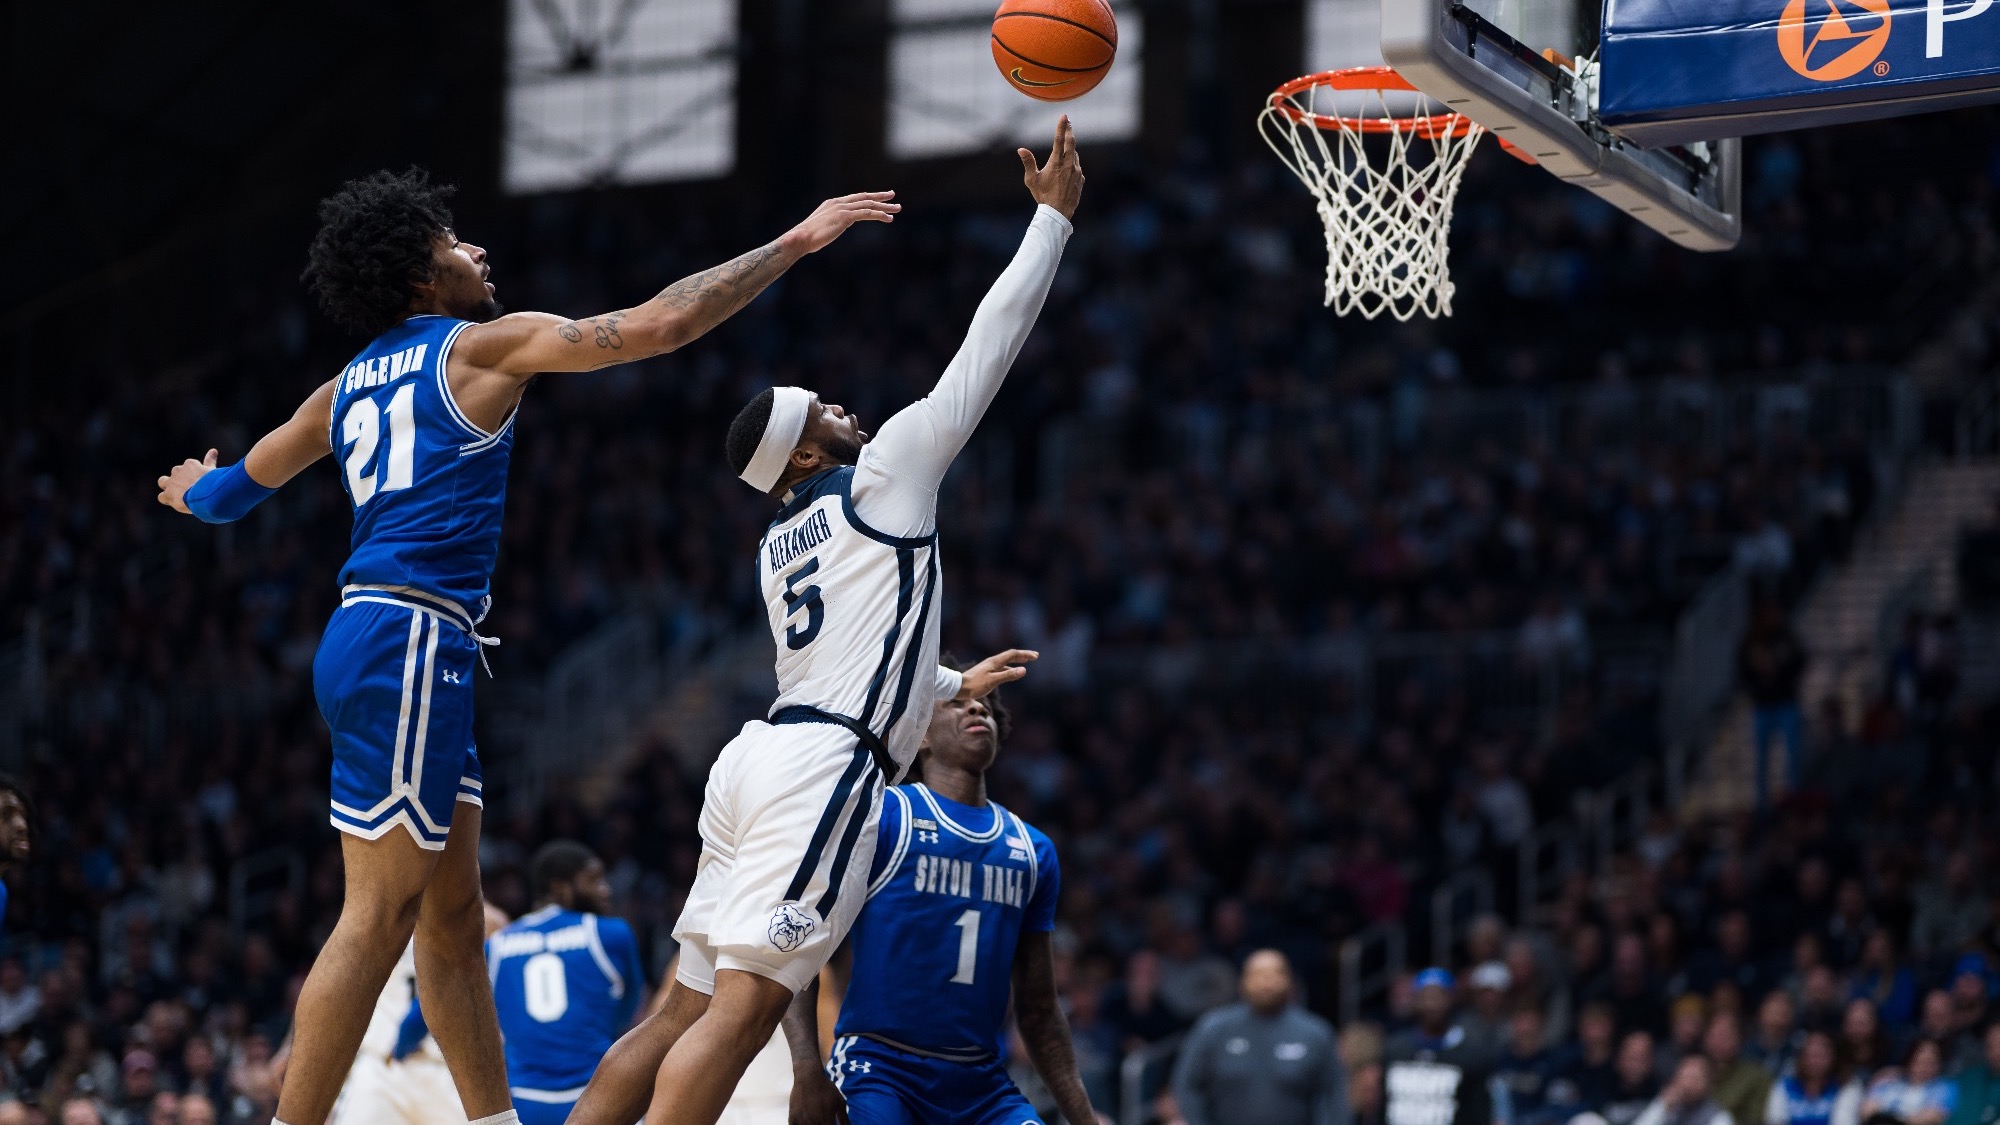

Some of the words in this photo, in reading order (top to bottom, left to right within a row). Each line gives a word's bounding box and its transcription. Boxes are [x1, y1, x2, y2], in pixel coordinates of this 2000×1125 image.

[345, 343, 429, 394] COLEMAN
[343, 383, 416, 507] 21
[768, 508, 833, 575] ALEXANDER
[782, 555, 825, 651] 5
[914, 854, 972, 899] SETON
[982, 863, 1024, 909] HALL
[949, 908, 981, 985] 1
[523, 952, 569, 1024] 0
